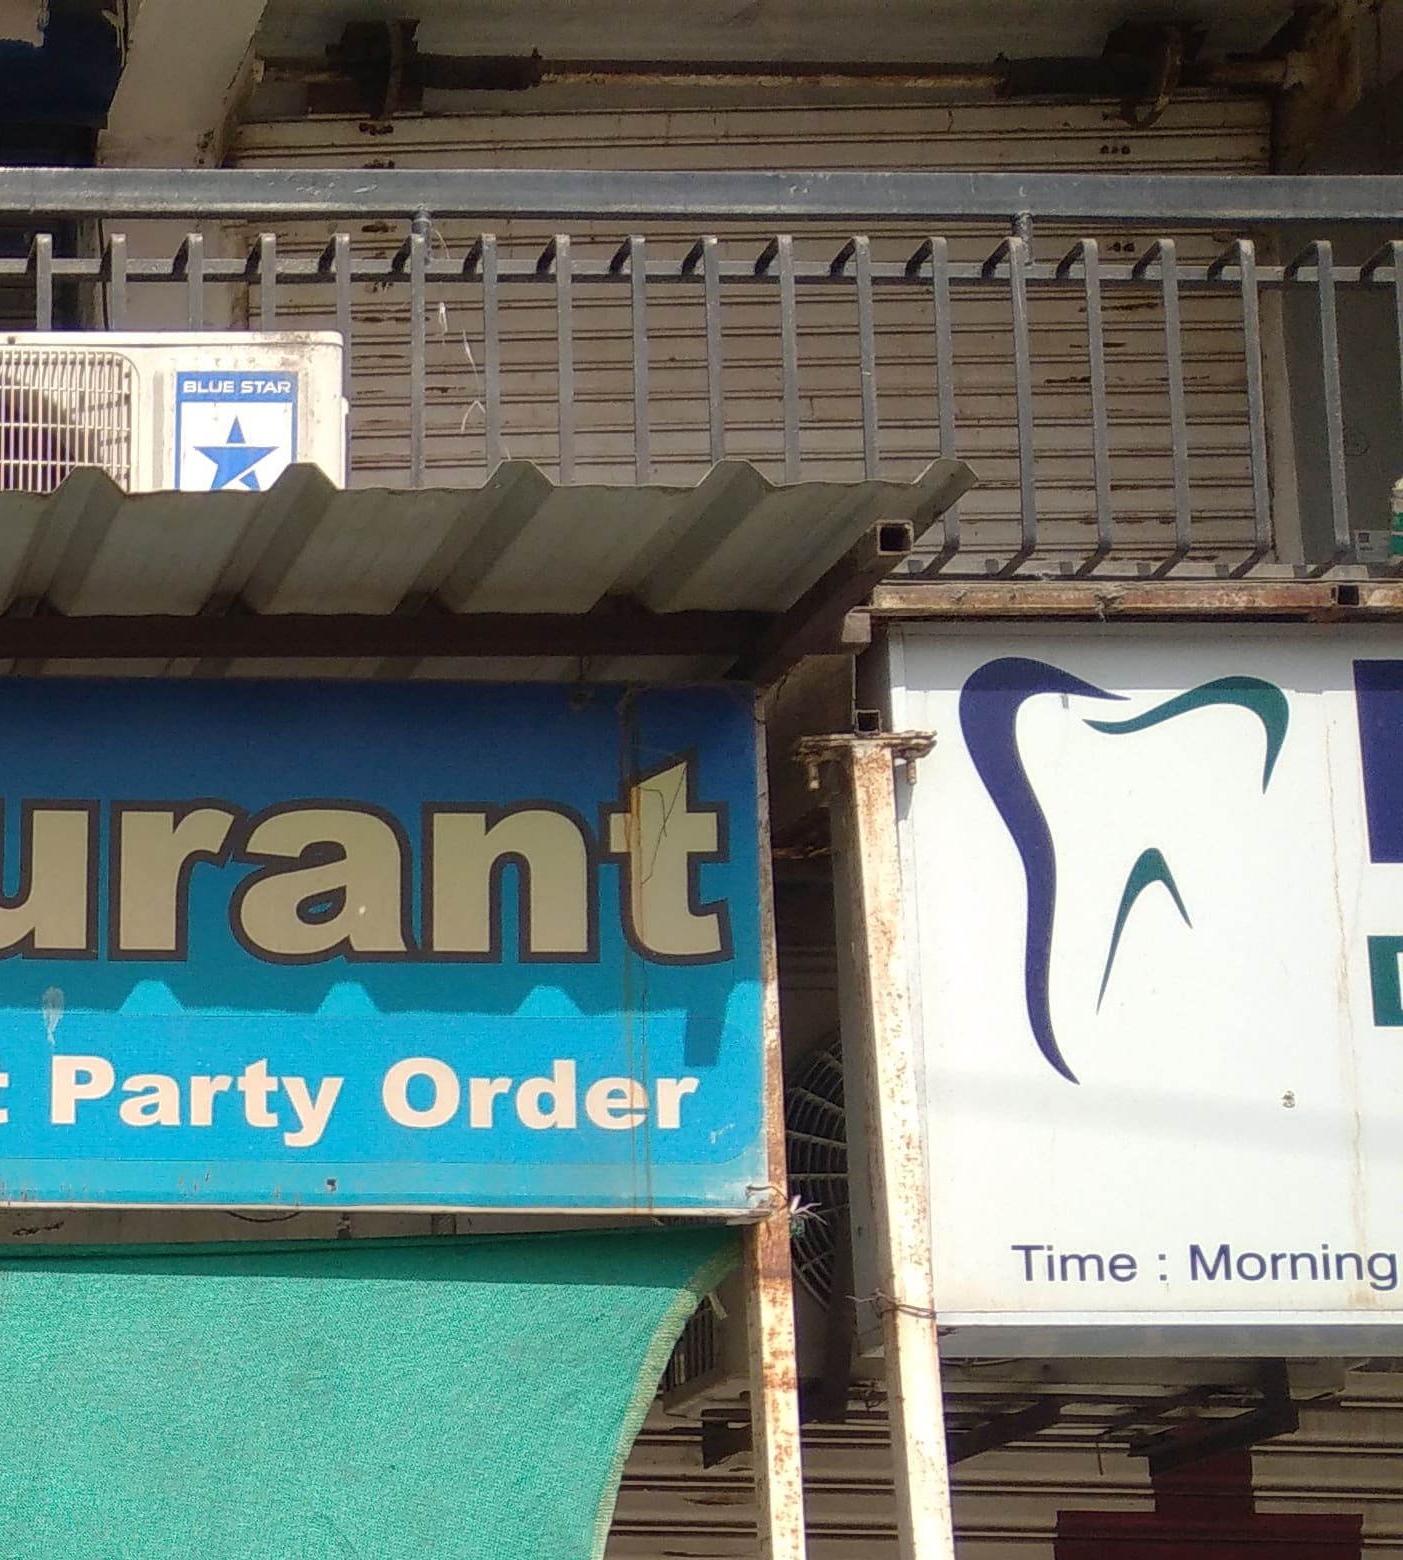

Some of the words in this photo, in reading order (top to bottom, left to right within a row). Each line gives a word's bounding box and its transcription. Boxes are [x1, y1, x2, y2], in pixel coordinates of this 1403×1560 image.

[182, 379, 236, 395] BLUE
[240, 380, 292, 395] STAR
[50, 1056, 345, 1147] Party
[381, 1057, 702, 1132] Order
[1010, 1244, 1138, 1282] Time
[1188, 1243, 1398, 1291] Morning
